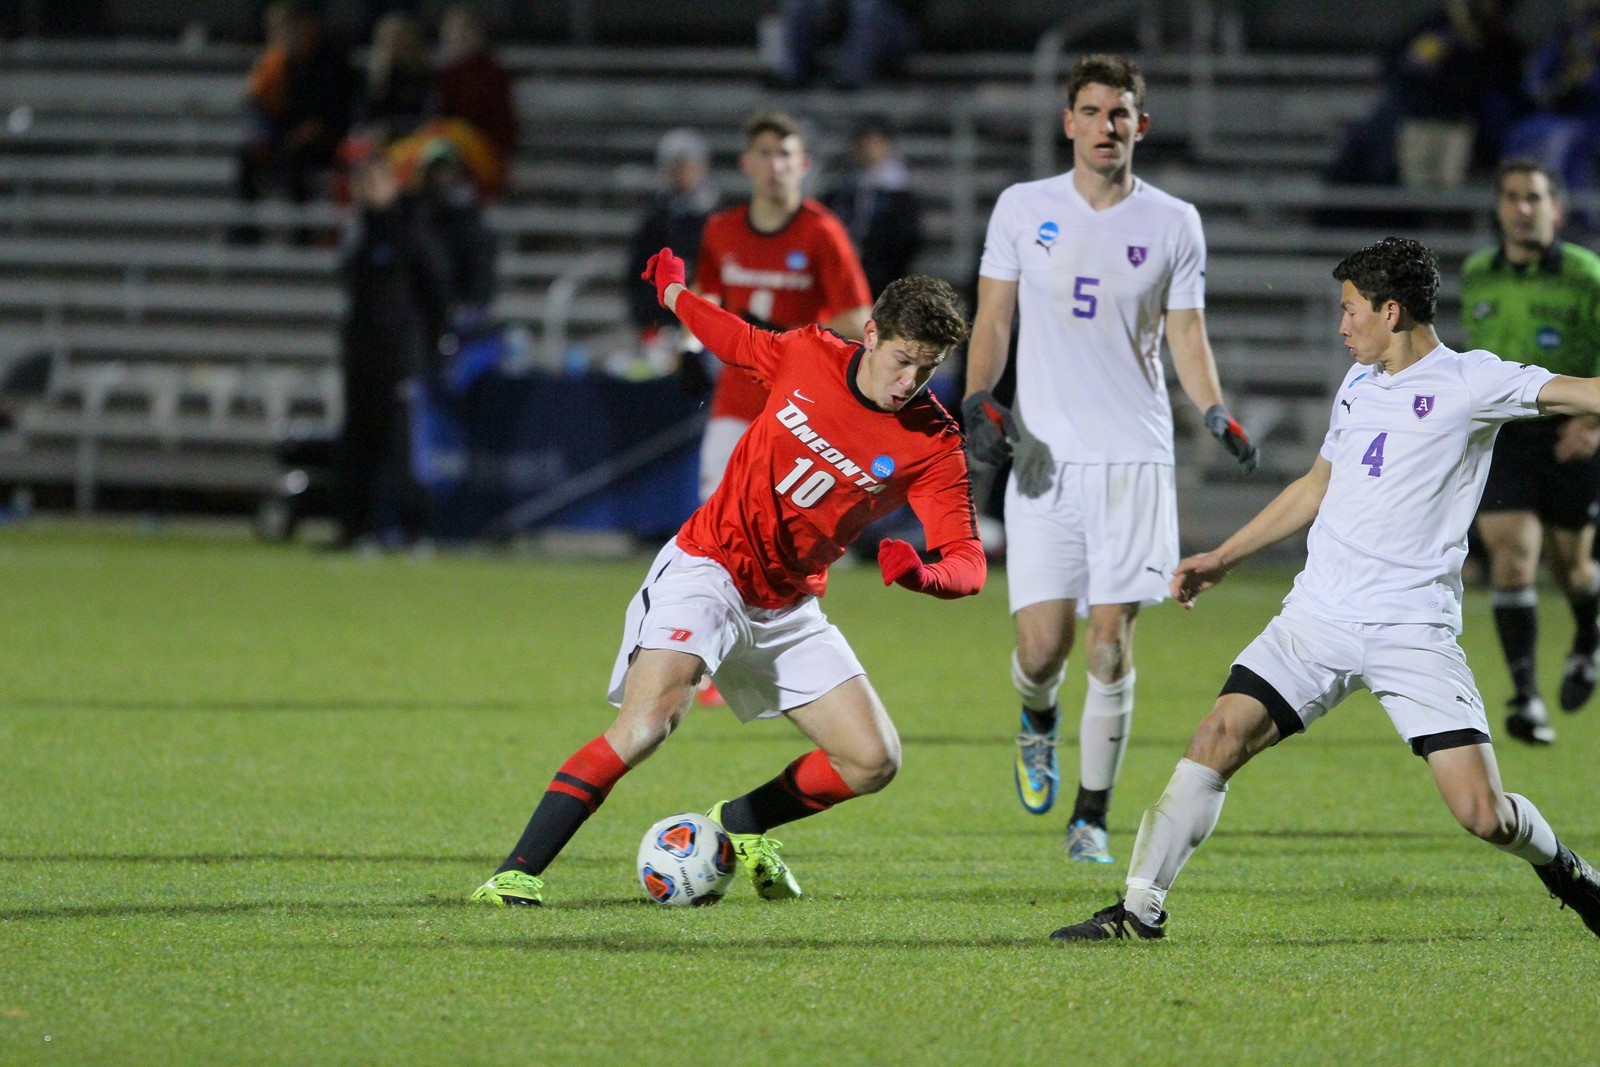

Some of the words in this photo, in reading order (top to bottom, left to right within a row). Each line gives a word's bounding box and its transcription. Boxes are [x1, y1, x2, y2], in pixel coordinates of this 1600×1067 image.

[1072, 276, 1099, 319] 5
[1415, 397, 1429, 412] A
[1361, 432, 1388, 477] 4
[774, 457, 836, 508] 10
